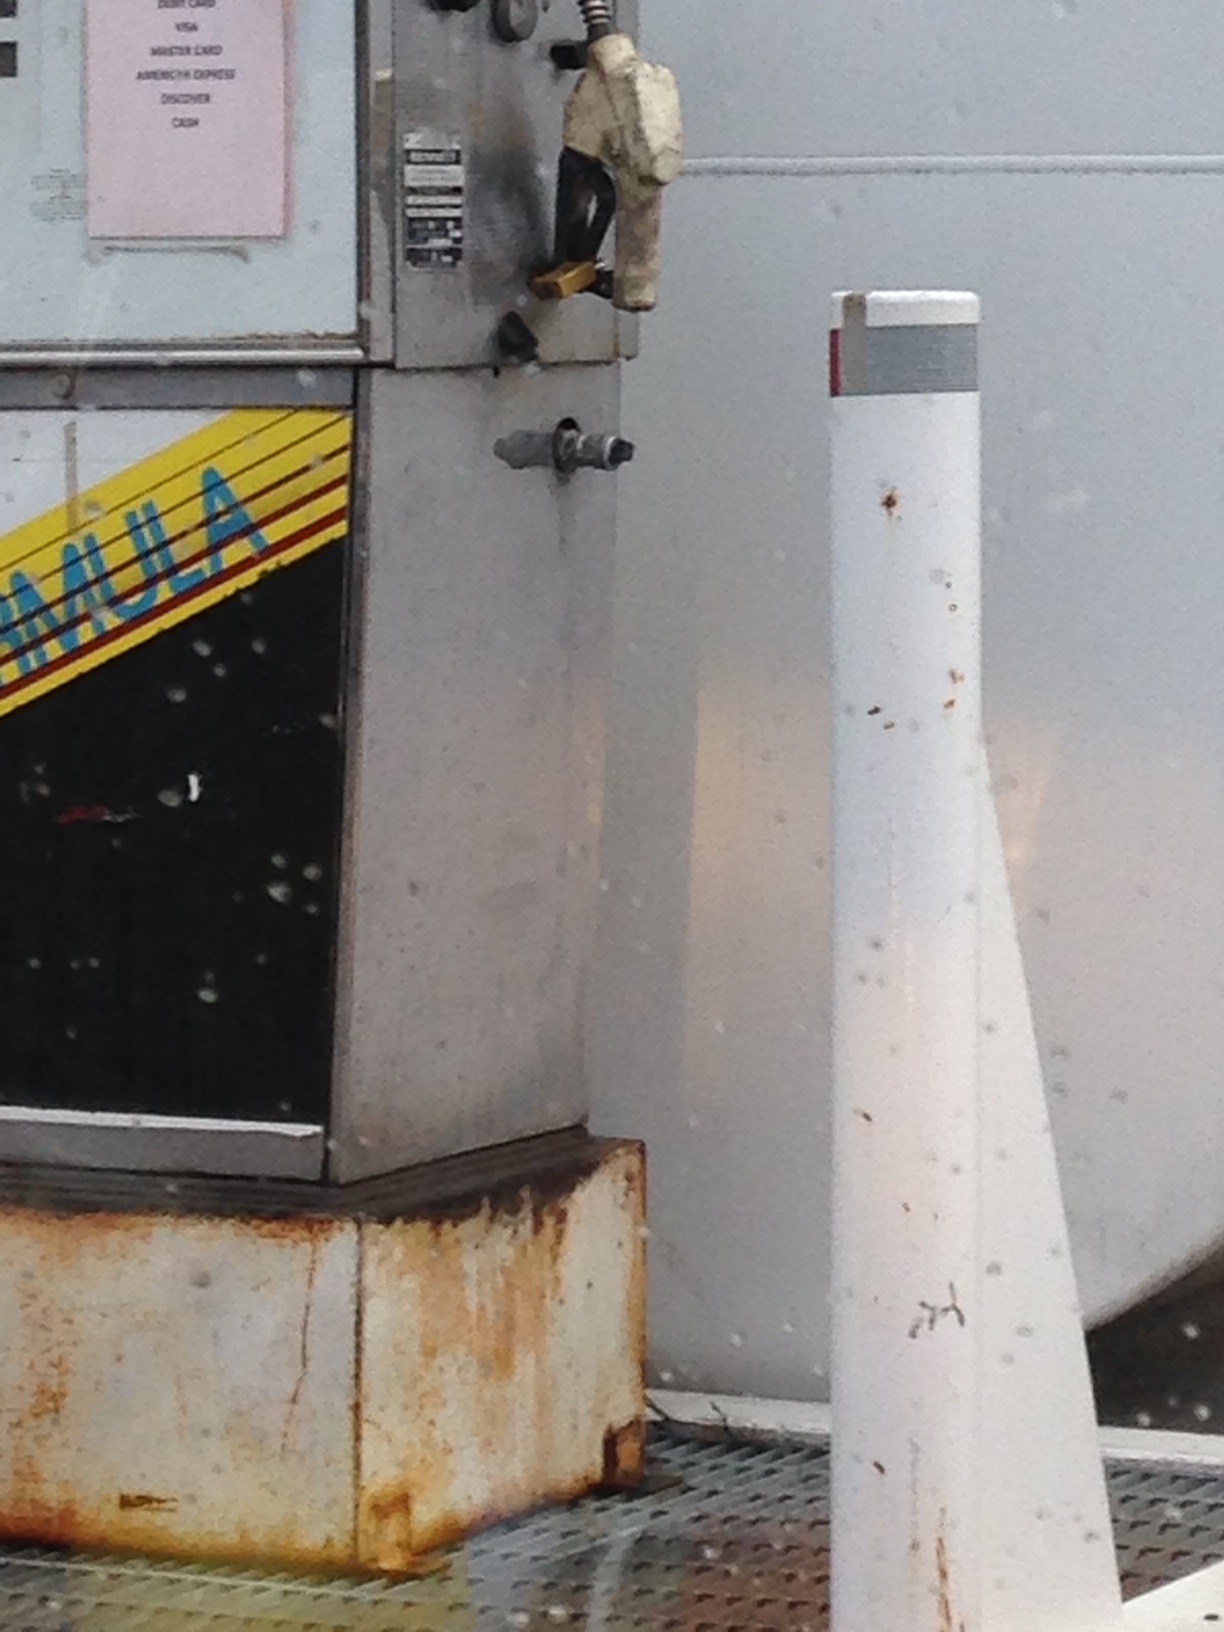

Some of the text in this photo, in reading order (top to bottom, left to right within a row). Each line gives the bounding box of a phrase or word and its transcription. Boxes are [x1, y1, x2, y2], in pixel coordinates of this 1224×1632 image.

[175, 21, 199, 32] VISA
[150, 45, 223, 57] MASTER CARD
[193, 68, 236, 80] EXPRESS
[160, 92, 210, 105] DISCOVER
[171, 116, 200, 128] CASH
